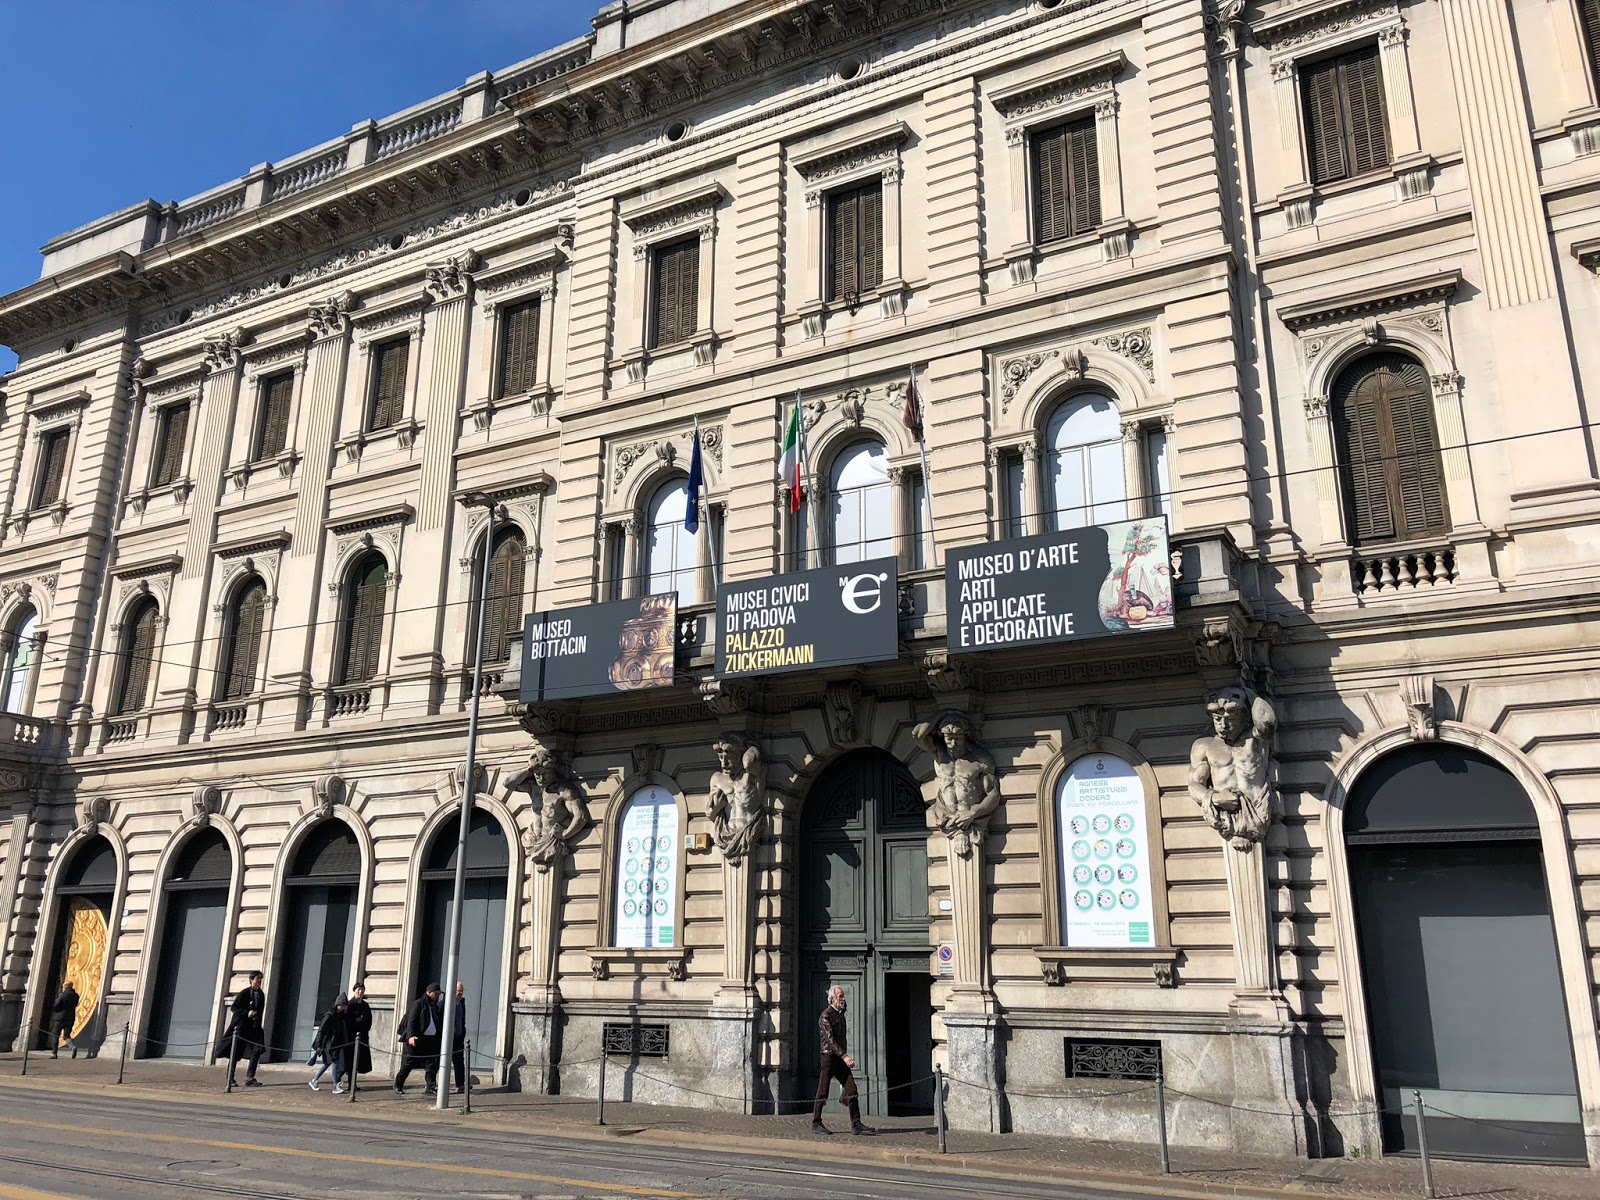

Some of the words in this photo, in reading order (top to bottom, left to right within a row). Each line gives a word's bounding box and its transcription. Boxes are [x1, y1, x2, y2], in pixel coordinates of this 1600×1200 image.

[958, 552, 1014, 580] MUSEO
[726, 588, 767, 613] MUSEI
[771, 582, 809, 606] CIVICI
[959, 577, 996, 602] ARTI
[726, 613, 739, 633] DI
[743, 605, 796, 630] PADOVA
[960, 593, 1047, 624] APPLICATE
[532, 619, 572, 641] MUSEO
[725, 627, 785, 653] PALAZZO
[960, 625, 970, 647] E
[974, 612, 1075, 645] DECORATIVE
[531, 635, 587, 660] BOTTACIN
[724, 644, 814, 674] ZUCKERMANN
